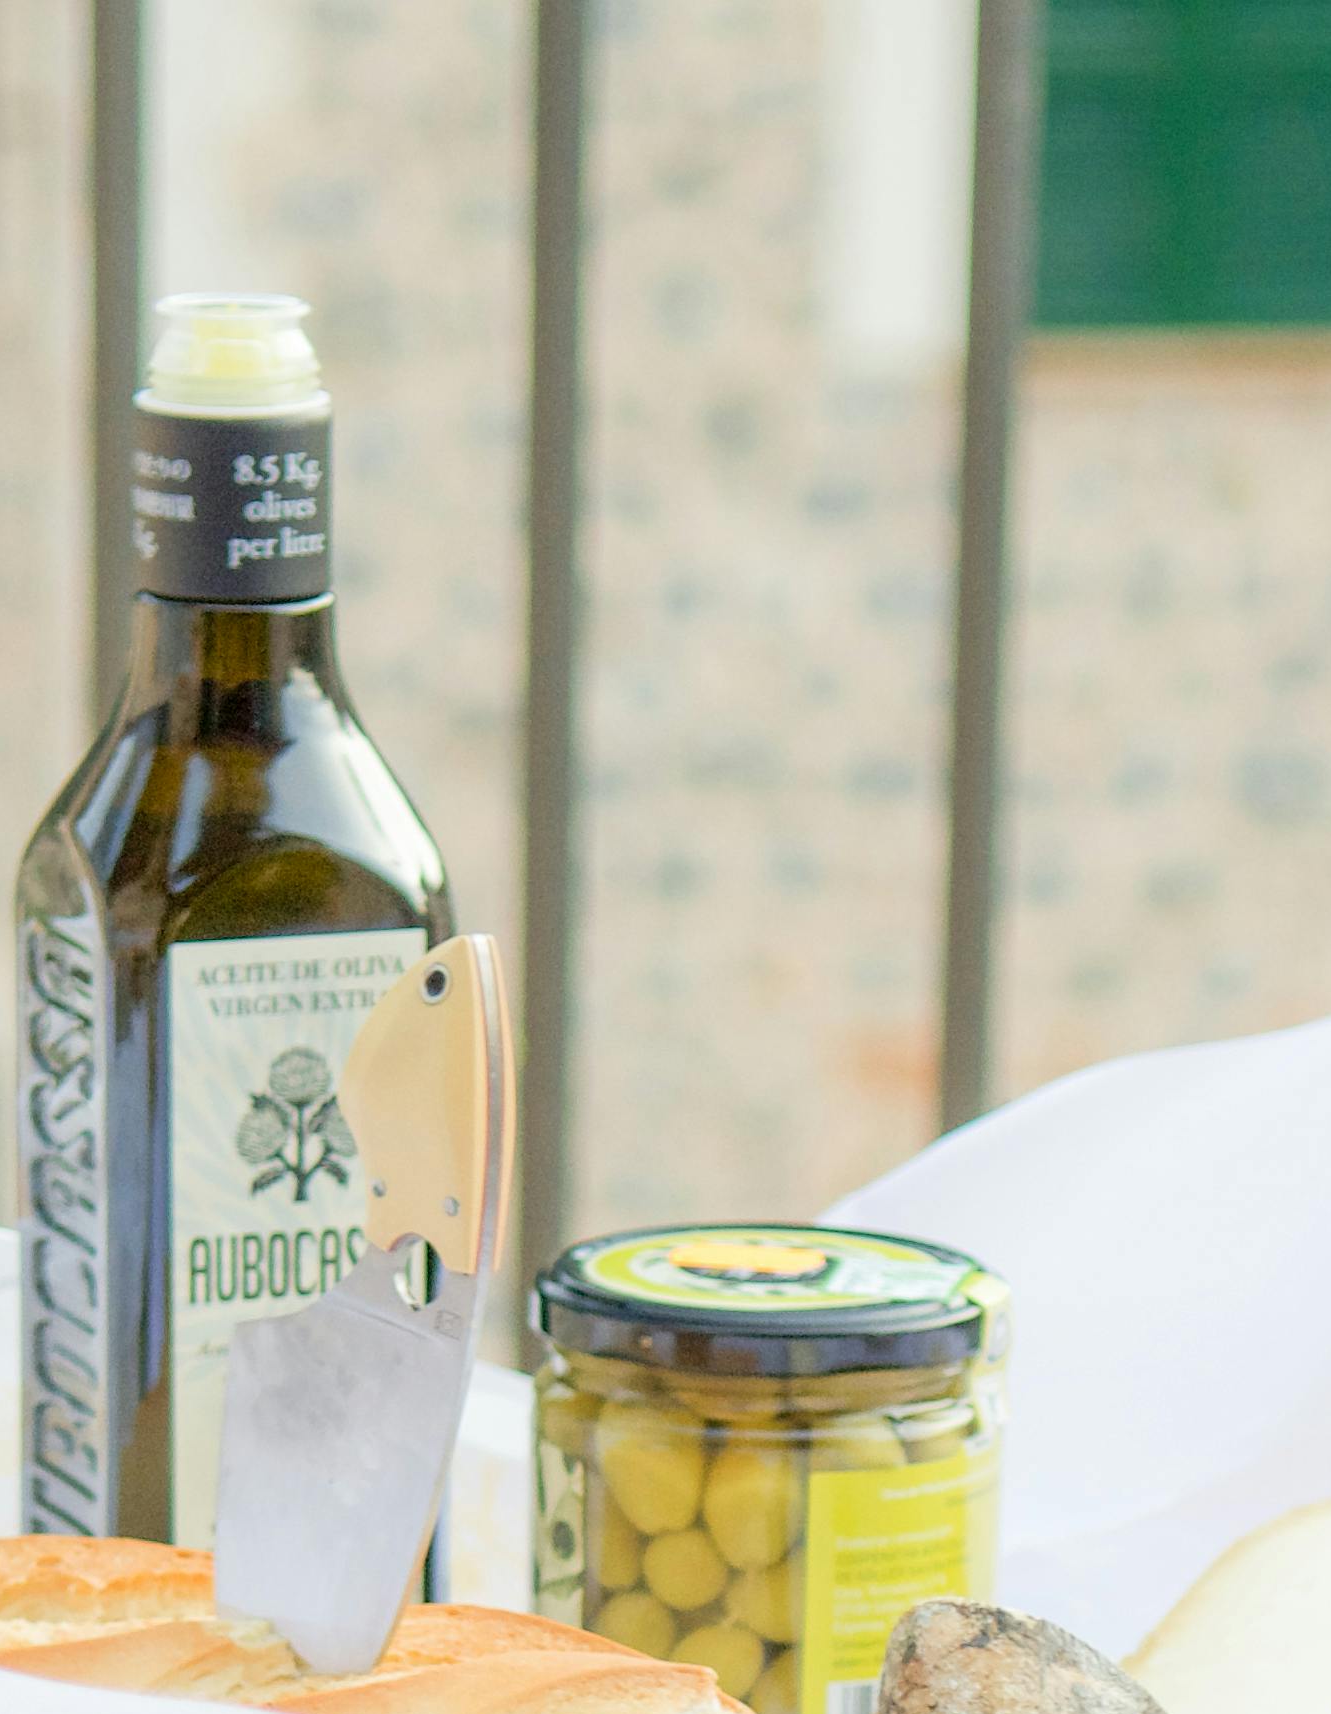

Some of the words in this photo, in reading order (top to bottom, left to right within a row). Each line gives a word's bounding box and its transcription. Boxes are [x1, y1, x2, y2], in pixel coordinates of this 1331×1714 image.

[232, 454, 281, 486] 8.5
[284, 451, 322, 491] Kg
[242, 490, 318, 522] olives
[227, 536, 278, 569] per
[197, 960, 286, 986] ACEITE
[291, 957, 327, 980] DE
[332, 954, 406, 977] OLIVA
[209, 991, 305, 1017] VIRGEN
[308, 987, 386, 1012] EXTR
